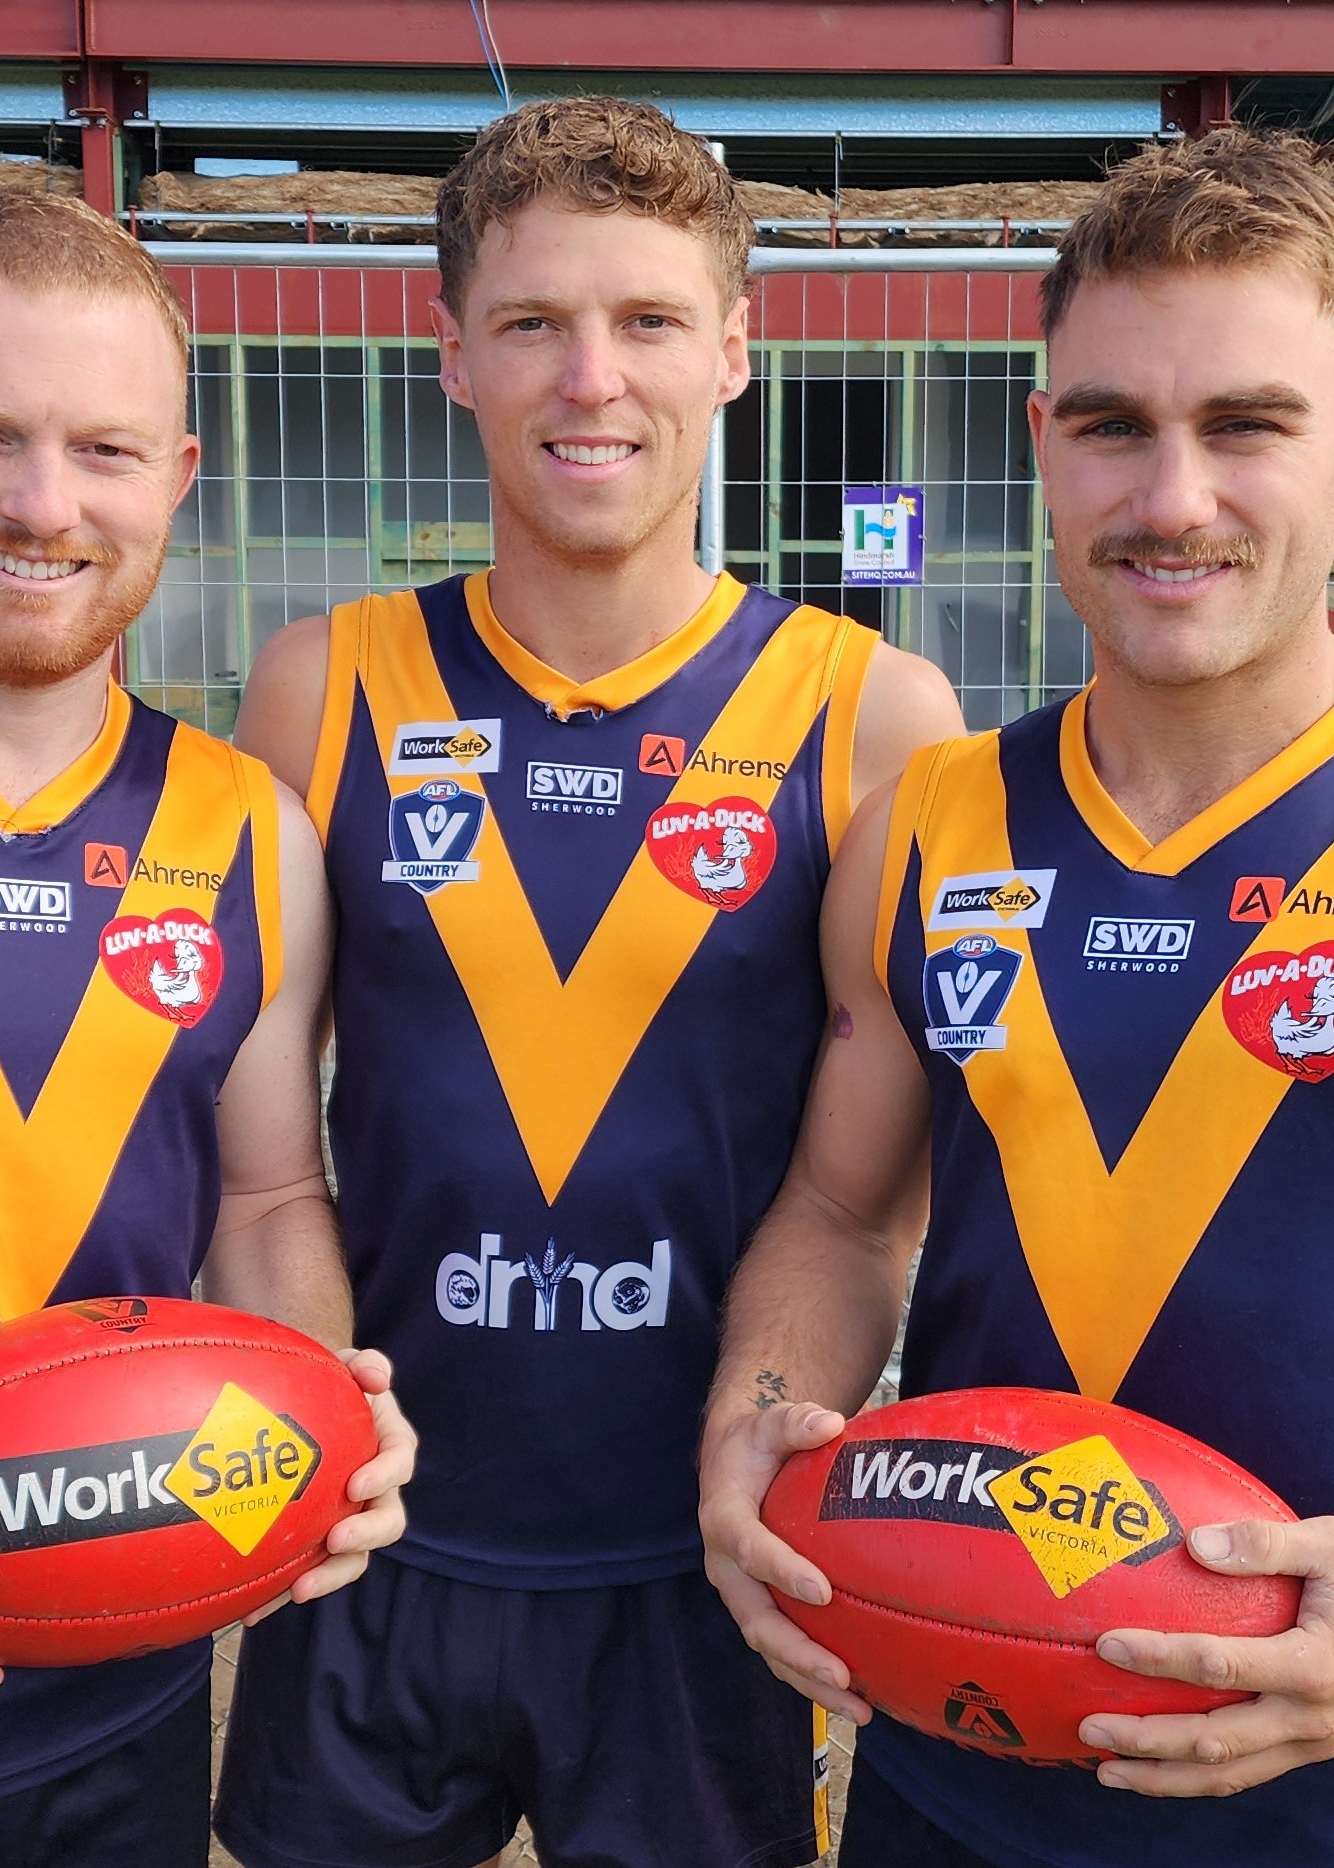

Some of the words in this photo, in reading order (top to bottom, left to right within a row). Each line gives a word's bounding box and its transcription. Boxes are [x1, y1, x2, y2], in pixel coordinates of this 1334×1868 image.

[851, 571, 916, 579] SITEHQCOM.AU
[689, 749, 787, 780] Ahrens
[423, 784, 457, 796] AFL
[532, 767, 617, 798] SWD
[531, 802, 616, 816] SHERWOOD
[134, 858, 222, 892] Ahrens
[400, 864, 459, 877] COUNTRY
[956, 939, 993, 953] AFL
[1091, 923, 1187, 953] SWD
[1087, 960, 1179, 973] SHERWOOD
[937, 1029, 987, 1046] COUNTRY
[99, 1316, 147, 1329] COUNTRY
[213, 1493, 281, 1519] VICTORIA
[1028, 1525, 1109, 1559] VICTORIA
[950, 1687, 999, 1707] COUNTRY
